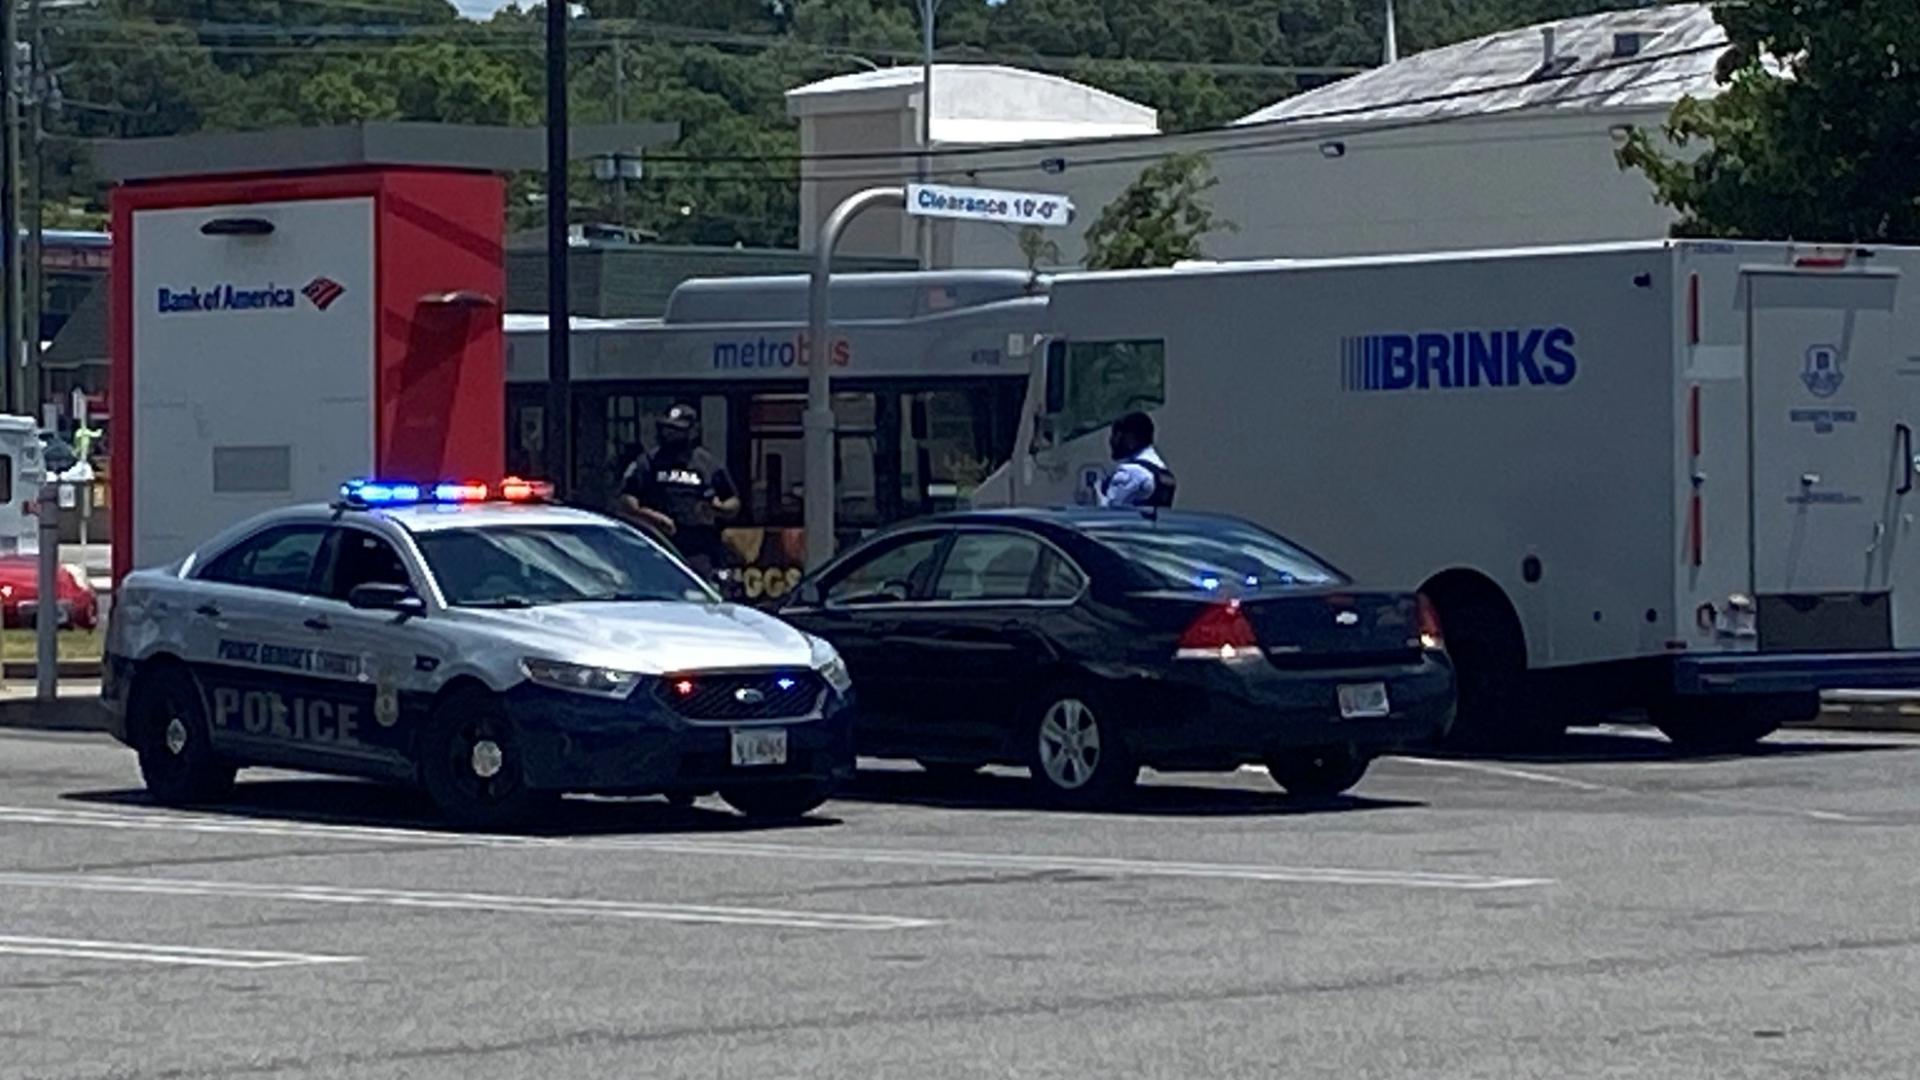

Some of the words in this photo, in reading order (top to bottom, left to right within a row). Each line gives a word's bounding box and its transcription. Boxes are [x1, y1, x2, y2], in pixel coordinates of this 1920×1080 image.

[918, 188, 1008, 215] Clearance
[158, 285, 202, 313] Bank
[203, 284, 222, 310] of
[223, 283, 295, 310] America
[713, 332, 850, 369] metrobs
[1380, 326, 1577, 391] BRINKS
[213, 686, 360, 746] POLICE
